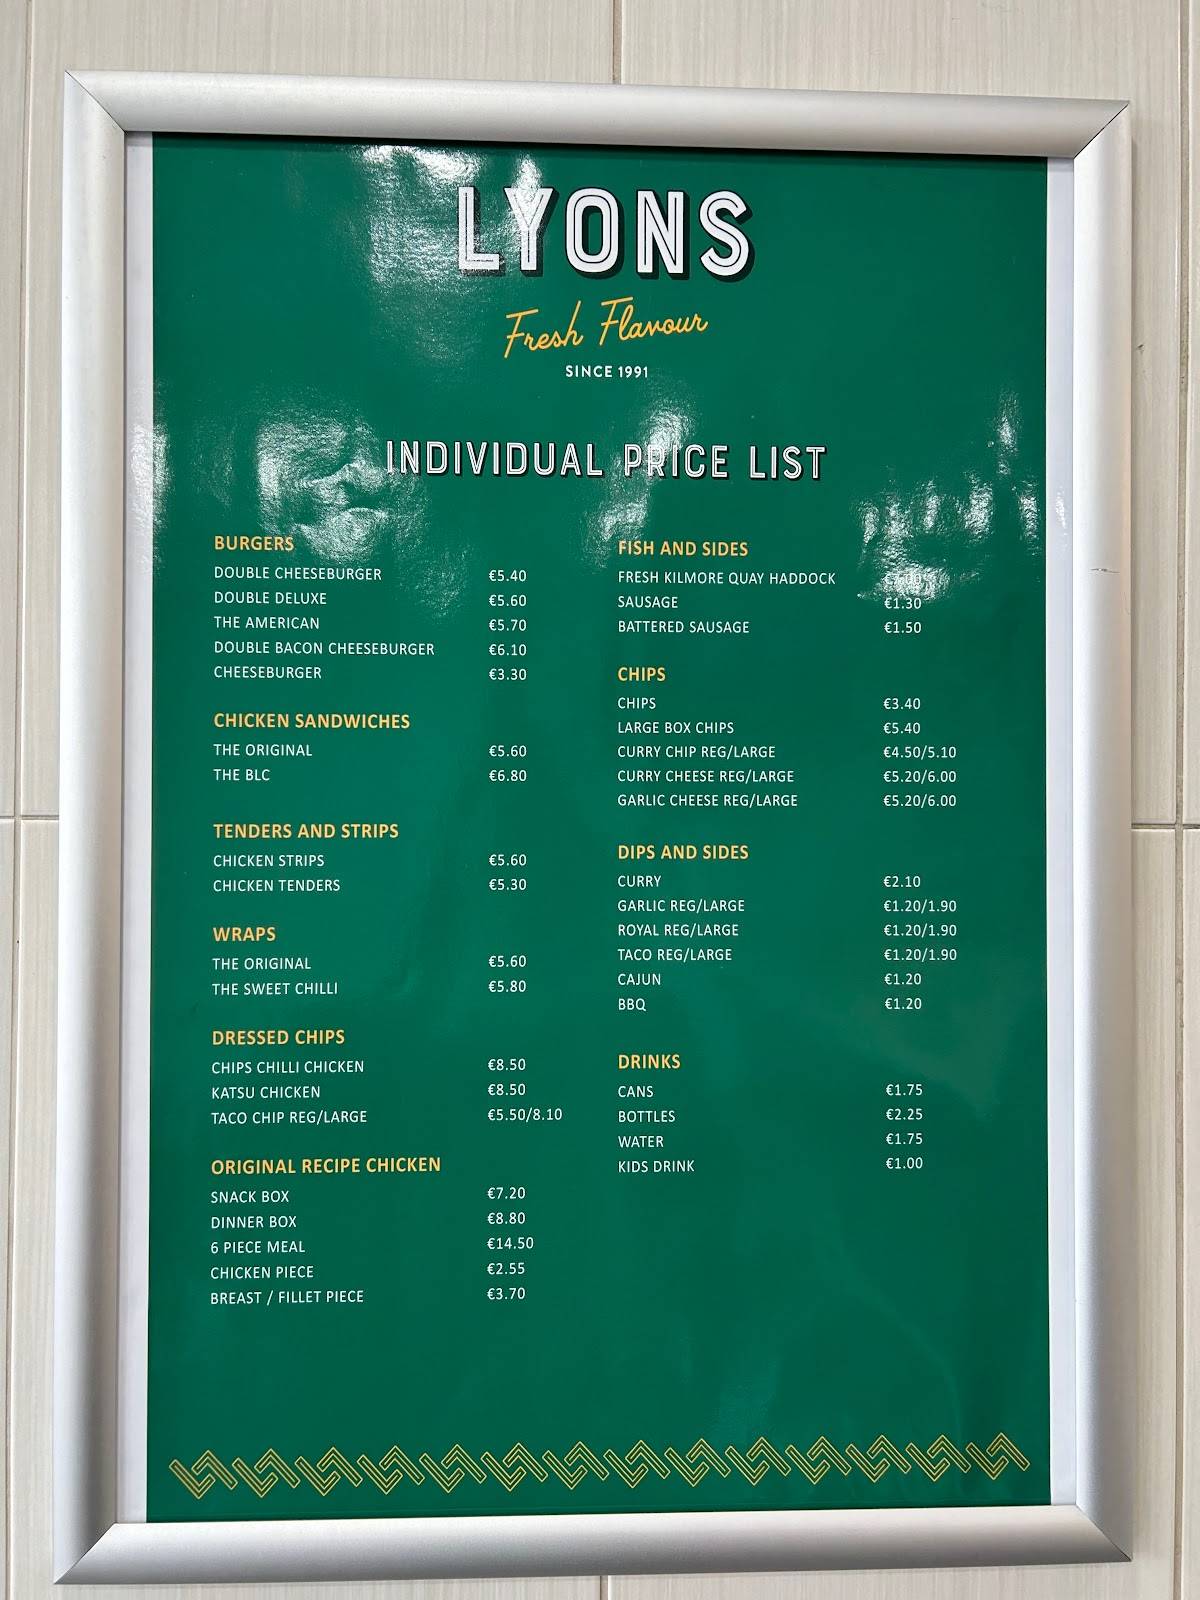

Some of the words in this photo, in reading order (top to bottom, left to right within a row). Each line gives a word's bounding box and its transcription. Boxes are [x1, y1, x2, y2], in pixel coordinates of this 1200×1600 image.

[458, 186, 755, 283] LYONS
[503, 300, 584, 358] Fresh
[598, 296, 709, 346] Flavour
[565, 364, 613, 378] SINCE
[617, 365, 649, 379] 1991
[386, 440, 604, 478] INDIVIDUAL
[624, 444, 729, 480] PRICE
[749, 445, 828, 481] LIST
[214, 535, 294, 551] BURGERS
[618, 540, 654, 556] FISH
[659, 540, 697, 556] AND
[702, 541, 749, 557] SIDES
[214, 566, 270, 579] DOUBLE
[274, 566, 382, 581] CHEESEBURGER
[488, 569, 527, 582] €5.40
[618, 570, 659, 584] FRESH
[664, 571, 724, 585] KILMORE
[728, 572, 764, 586] QUAY
[769, 572, 836, 585] HADDOCK
[214, 591, 270, 604] DOUBLE
[275, 591, 327, 605] DELUXE
[488, 594, 527, 607] €5.60
[617, 595, 678, 609] SAUSAGE
[884, 597, 922, 610] €1.30
[213, 615, 240, 629] THE
[245, 616, 320, 630] AMERICAN
[488, 618, 527, 632] €5.70
[618, 620, 685, 633] BATTERED
[689, 620, 750, 634] SAUSAGE
[883, 621, 922, 634] €1.50
[214, 640, 270, 654] DOUBLE
[275, 641, 323, 655] BACON
[328, 642, 435, 656] CHEESEBURGER
[488, 643, 527, 656] €6.10
[213, 665, 322, 679] CHEESEBURGER
[488, 668, 527, 681] €3.30
[617, 666, 666, 682] CHIPS
[617, 696, 656, 710] CHIPS
[883, 697, 921, 710] €3.40
[213, 712, 290, 728] CHICKEN
[295, 713, 410, 729] SANDWICHES
[618, 721, 660, 734] LARGE
[664, 721, 691, 734] BOX
[695, 721, 734, 734] CHIPS
[883, 722, 921, 735] €5.40
[213, 743, 241, 756] THE
[245, 743, 313, 757] ORIGINAL
[488, 744, 527, 758] €5.60
[617, 745, 661, 758] CURRY
[665, 745, 697, 758] CHIP
[701, 744, 776, 760] REG/LARGE
[883, 745, 957, 761] €4.50/5.10
[213, 768, 240, 781] THE
[245, 768, 270, 781] BLC
[488, 769, 527, 782] €6.80
[617, 769, 661, 782] CURRY
[665, 770, 715, 783] CHEESE
[719, 769, 794, 785] REG/LARGE
[883, 769, 957, 785] €5.20/6.00
[617, 794, 665, 807] GARLIC
[669, 794, 719, 807] CHEESE
[723, 793, 798, 809] REG/LARGE
[883, 793, 957, 809] €5.20/6.00
[213, 823, 292, 839] TENDERS
[297, 823, 336, 839] AND
[341, 823, 399, 839] STRIPS
[618, 844, 656, 860] DIPS
[660, 844, 698, 860] AND
[702, 844, 749, 860] SIDES
[213, 854, 274, 867] CHICKEN
[278, 854, 325, 867] STRIPS
[488, 853, 527, 867] €5.60
[213, 879, 274, 892] CHICKEN
[278, 879, 341, 892] TENDERS
[488, 878, 527, 891] €5.30
[617, 875, 662, 888] CURRY
[883, 875, 921, 888] €2.10
[617, 899, 666, 912] GARLIC
[670, 898, 745, 914] REG/LARGE
[883, 899, 957, 914] €1.20/1.90
[212, 926, 276, 942] WRAPS
[618, 923, 660, 937] ROYAL
[664, 922, 739, 938] REG/LARGE
[883, 923, 957, 938] €1.20/1.90
[488, 954, 527, 968] €5.60
[617, 948, 652, 961] TACO
[657, 947, 732, 963] REG/LARGE
[883, 947, 957, 963] €1.20/1.90
[212, 957, 239, 970] THE
[244, 957, 312, 970] ORIGINAL
[617, 973, 661, 986] CAJUN
[884, 972, 922, 985] €1.20
[211, 983, 239, 996] THE
[243, 982, 291, 996] SWEET
[295, 982, 338, 995] CHILLI
[488, 979, 527, 993] €5.80
[618, 997, 647, 1012] BBQ
[884, 997, 922, 1010] €1.20
[212, 1029, 289, 1046] DRESSED
[295, 1029, 345, 1045] CHIPS
[211, 1061, 252, 1075] CHIPS
[256, 1061, 299, 1074] CHILLI
[304, 1060, 364, 1074] CHICKEN
[487, 1058, 526, 1071] €8.50
[618, 1053, 681, 1070] DRINKS
[211, 1086, 255, 1100] KATSU
[260, 1085, 320, 1099] CHICKEN
[487, 1083, 526, 1096] €8.50
[617, 1085, 654, 1098] CANS
[885, 1083, 923, 1096] €1.75
[210, 1111, 248, 1125] TACO
[252, 1111, 285, 1124] CHIP
[289, 1109, 367, 1126] REG/LARGE
[487, 1107, 563, 1123] €5.50/8.10
[618, 1110, 676, 1123] BOTTLES
[885, 1108, 923, 1121] €2.25
[617, 1135, 664, 1148] WATER
[885, 1132, 923, 1145] €1.75
[211, 1159, 296, 1175] ORIGINAL
[301, 1157, 361, 1174] RECIPE
[365, 1157, 441, 1173] CHICKEN
[618, 1160, 649, 1173] KIDS
[653, 1159, 695, 1173] DRINK
[885, 1156, 923, 1170] €1.00
[210, 1190, 257, 1204] SNACK
[261, 1190, 289, 1203] BOX
[487, 1186, 526, 1200] €7.20
[211, 1215, 264, 1229] DINNER
[269, 1215, 297, 1228] BOX
[487, 1211, 526, 1225] €8.80
[210, 1241, 219, 1254] 6
[223, 1240, 262, 1254] PIECE
[267, 1240, 306, 1253] MEAL
[486, 1236, 534, 1250] €14.50
[210, 1266, 271, 1280] CHICKEN
[276, 1265, 314, 1279] PIECE
[486, 1262, 525, 1275] €2.55
[210, 1291, 262, 1305] BREAST
[266, 1290, 274, 1306] /
[278, 1290, 322, 1304] FILLET
[326, 1290, 364, 1303] PIECE
[486, 1287, 526, 1300] €3.70
